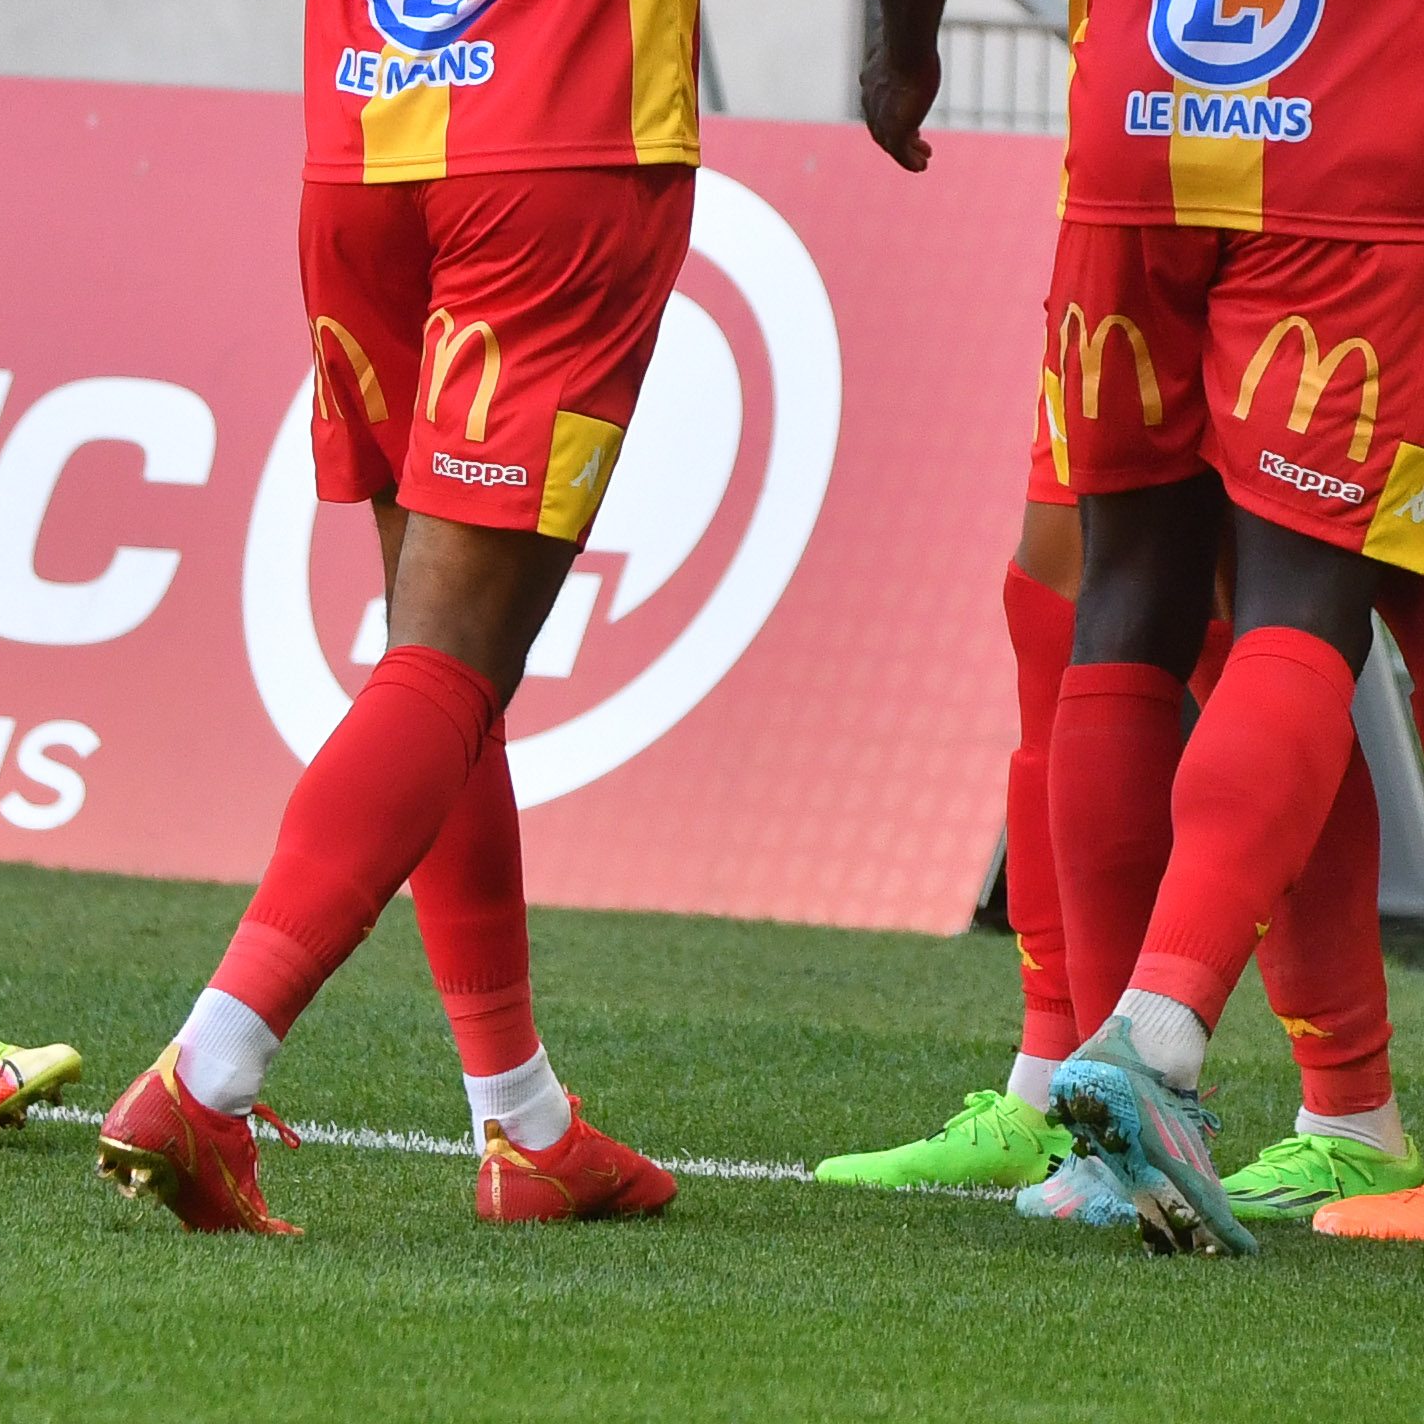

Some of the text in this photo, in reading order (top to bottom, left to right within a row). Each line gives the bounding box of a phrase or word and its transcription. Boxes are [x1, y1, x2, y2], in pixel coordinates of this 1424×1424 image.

[338, 46, 490, 95] LE MANS
[1129, 95, 1307, 137] LE MANS
[432, 451, 528, 487] Kappa
[1259, 449, 1365, 505] Kappa
